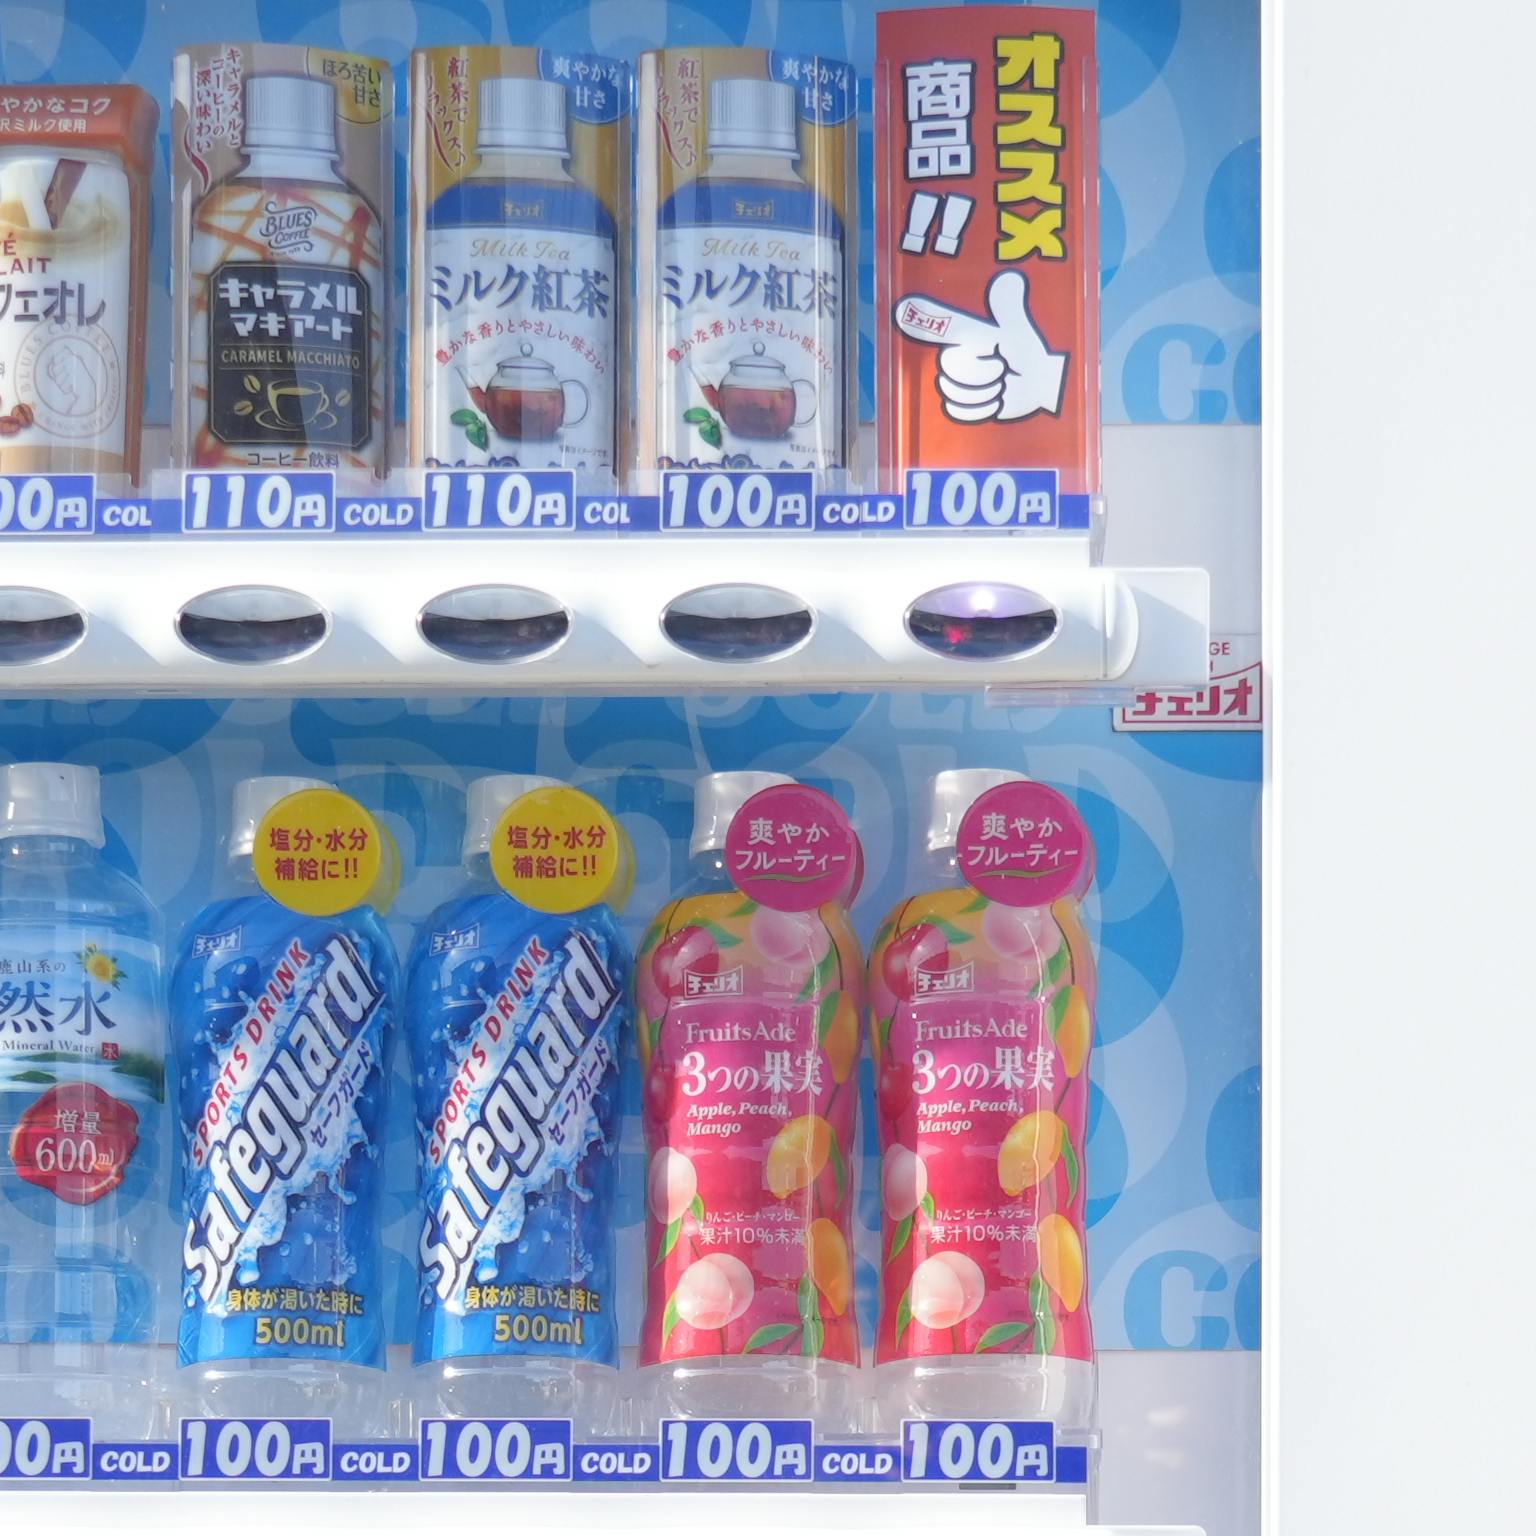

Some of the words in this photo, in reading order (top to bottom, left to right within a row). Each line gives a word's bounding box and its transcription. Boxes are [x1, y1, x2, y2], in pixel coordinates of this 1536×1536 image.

[994, 32, 1065, 262] オススメ
[470, 238, 529, 258] Milk
[534, 240, 571, 261] Tea
[219, 278, 362, 316] キャラメル
[429, 264, 610, 319] ミルク紅茶
[661, 263, 838, 319] ミルク紅茶
[229, 312, 353, 341] マキアート
[221, 349, 283, 364] CARAMEL
[287, 351, 360, 369] MACCHIATO
[191, 475, 328, 528] 110円
[344, 504, 414, 527] COLD
[430, 474, 566, 528] 110円
[910, 471, 1051, 525] 100円
[269, 827, 369, 853] 塩分・水分
[749, 818, 831, 846] 爽やか
[735, 848, 847, 873] フルーティー
[192, 1042, 250, 1160] SPORTS
[245, 938, 310, 1042] DRINK
[681, 1050, 825, 1098] 3つの果実
[180, 932, 385, 1302] Safeguard
[418, 930, 624, 1300] Safeguard
[687, 1120, 742, 1137] Mango
[225, 1288, 365, 1316] 身体が渇いた時に
[255, 1316, 347, 1348] 500ml
[101, 1450, 170, 1473] COLD
[668, 1422, 806, 1478] 100円
